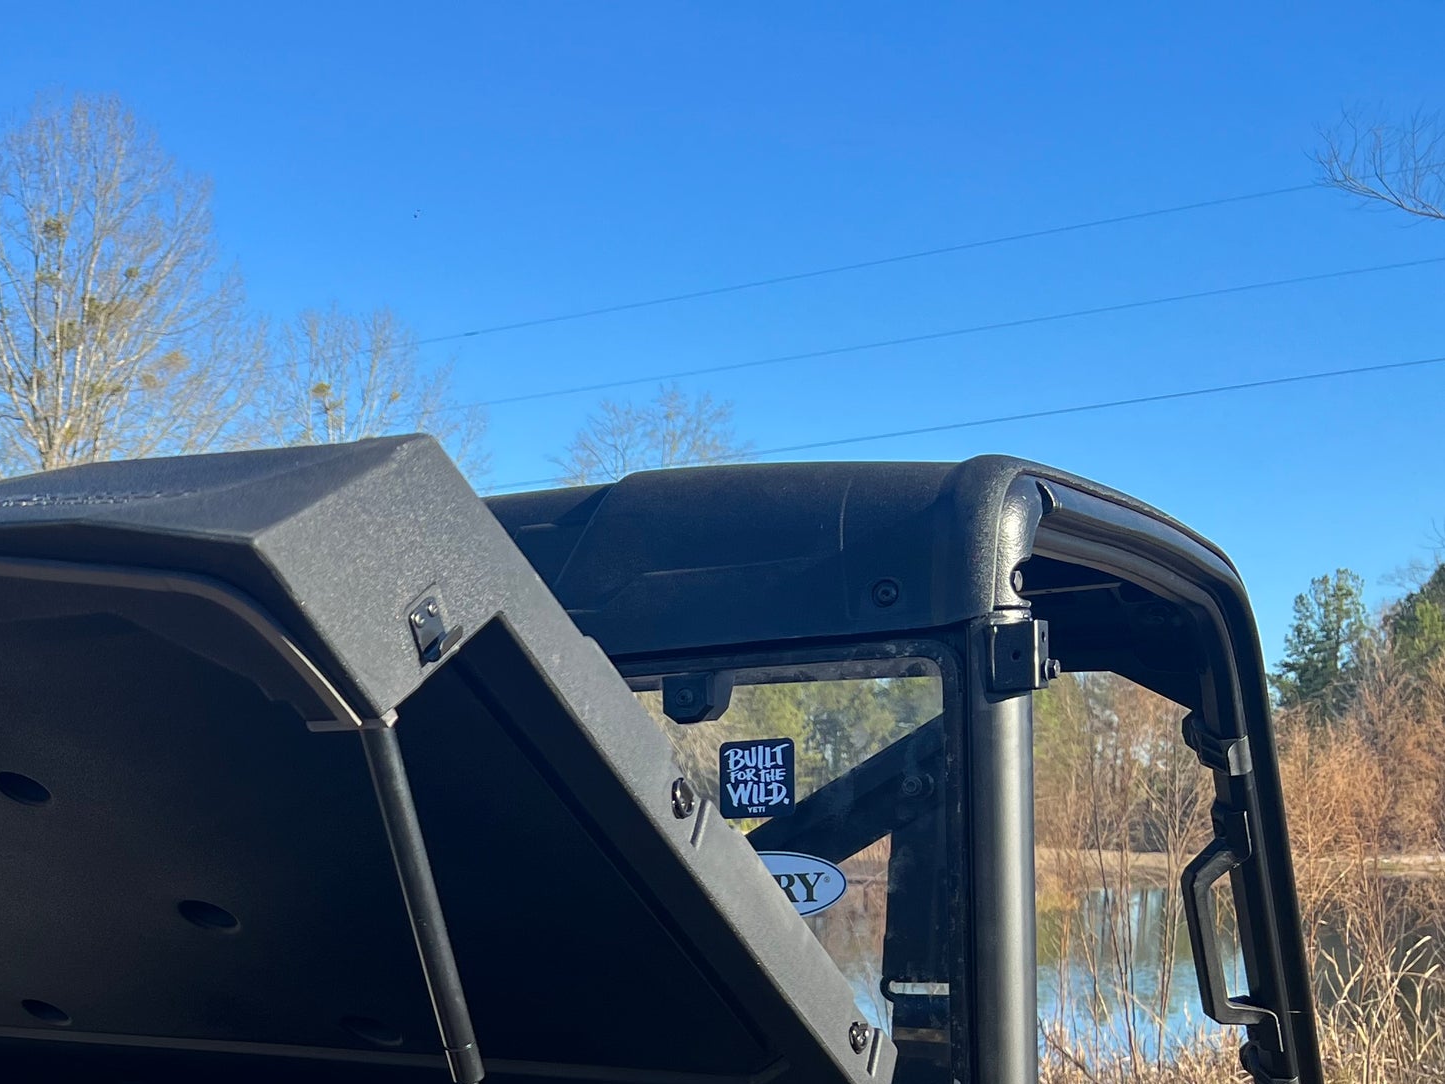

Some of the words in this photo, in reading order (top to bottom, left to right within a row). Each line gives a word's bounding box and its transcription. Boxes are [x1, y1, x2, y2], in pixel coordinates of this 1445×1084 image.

[724, 743, 790, 772] BUILT
[730, 768, 759, 784] FOR
[758, 768, 786, 783] THE
[726, 781, 790, 807] WILD.
